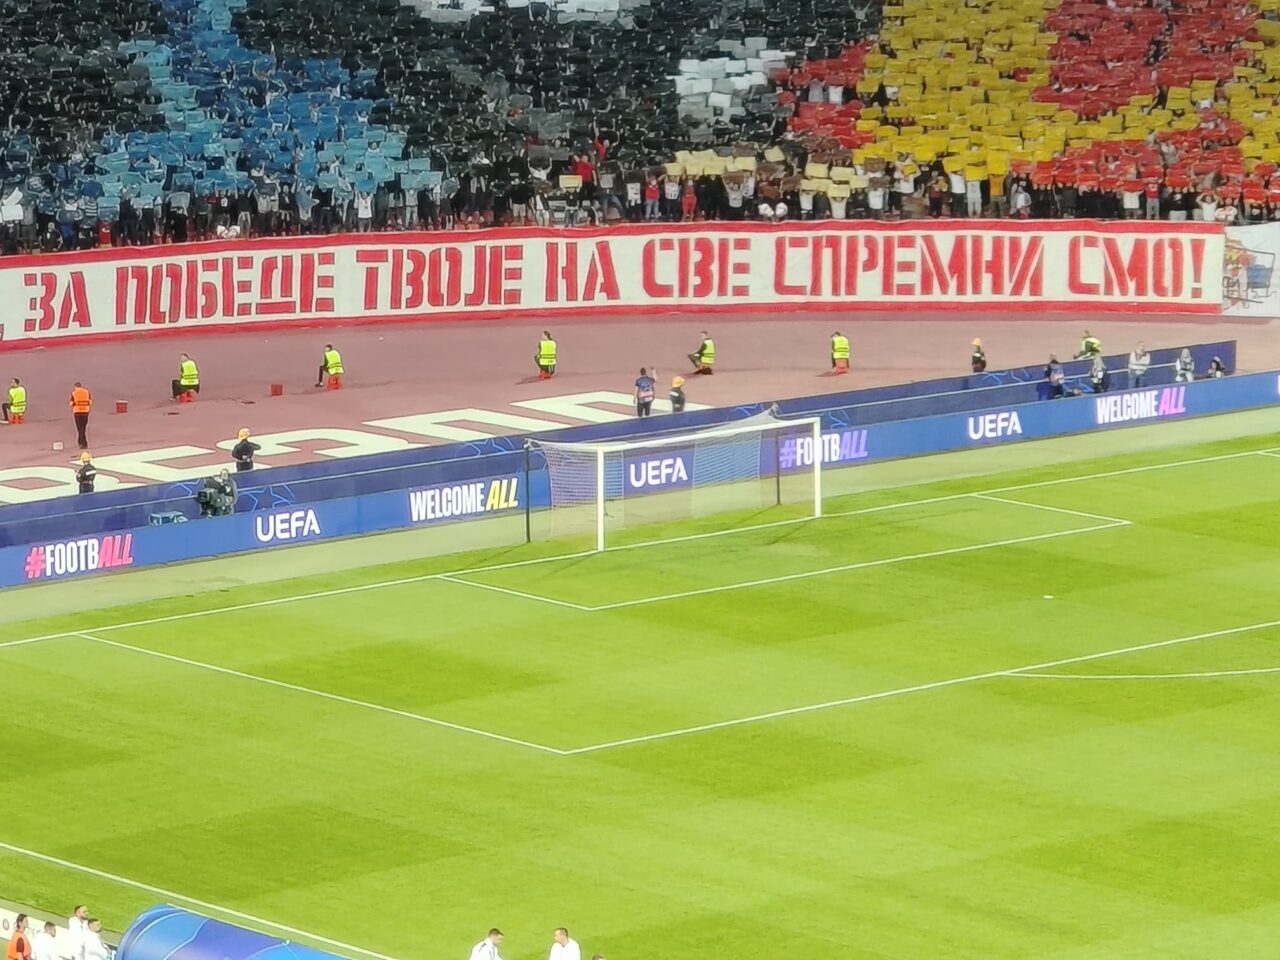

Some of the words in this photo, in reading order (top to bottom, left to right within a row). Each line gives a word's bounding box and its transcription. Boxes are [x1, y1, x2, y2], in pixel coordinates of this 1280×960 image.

[23, 270, 93, 332] ЗА
[115, 252, 335, 326] ПОБЕДЕ
[355, 244, 524, 311] ТВОЈЕ
[545, 239, 620, 302] НА
[642, 237, 752, 298] СВЕ
[773, 233, 1045, 298] СПРЕМНИ
[1068, 234, 1206, 299] СМО!
[1096, 390, 1158, 424] WELCOME
[1158, 386, 1186, 416] ALL
[969, 411, 1022, 440] UEFA
[630, 457, 688, 488] UEFA
[410, 483, 485, 522] WELCOME
[485, 478, 518, 511] ALL
[256, 510, 321, 542] UEFA
[24, 533, 134, 579] #FOOTBALL
